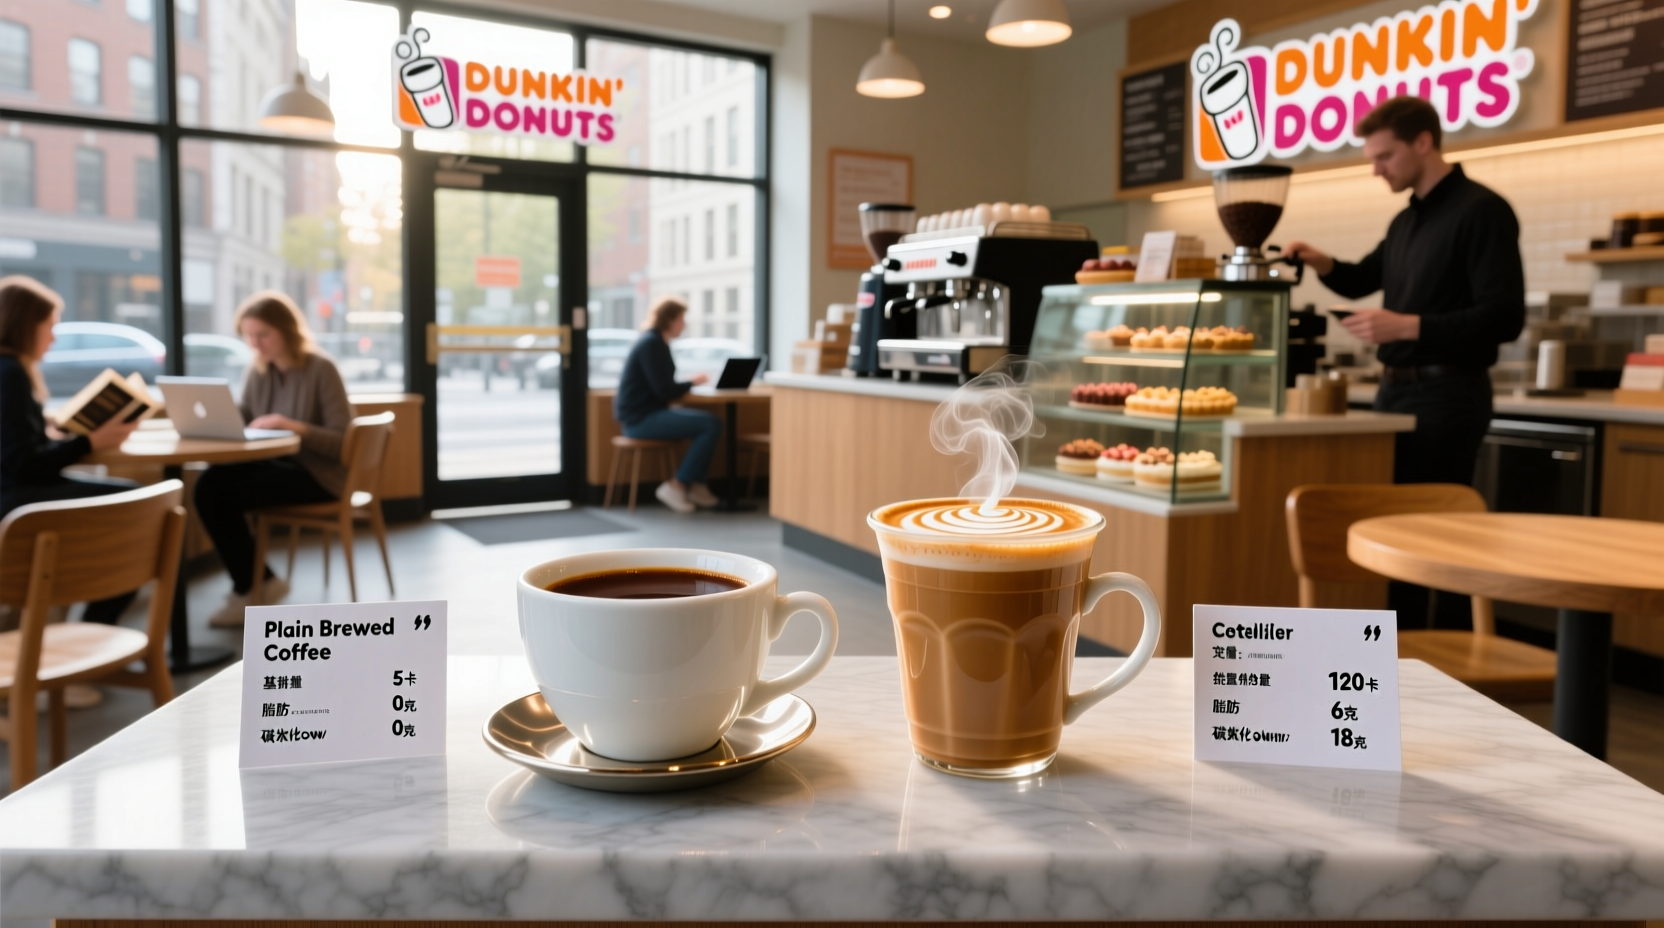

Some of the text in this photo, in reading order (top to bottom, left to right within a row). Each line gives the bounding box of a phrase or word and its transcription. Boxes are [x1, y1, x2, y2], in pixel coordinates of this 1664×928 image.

[465, 61, 623, 108] DUNKIN'
[466, 98, 615, 142] DONUTS
[265, 617, 395, 638] Plain Brewed
[264, 643, 332, 661] Coffee
[393, 670, 417, 687] 5卡
[1328, 671, 1379, 693] 120卡
[392, 694, 417, 712] 0克
[1331, 700, 1359, 721] 6克
[392, 719, 416, 737] 0克
[1330, 727, 1367, 749] 18克
